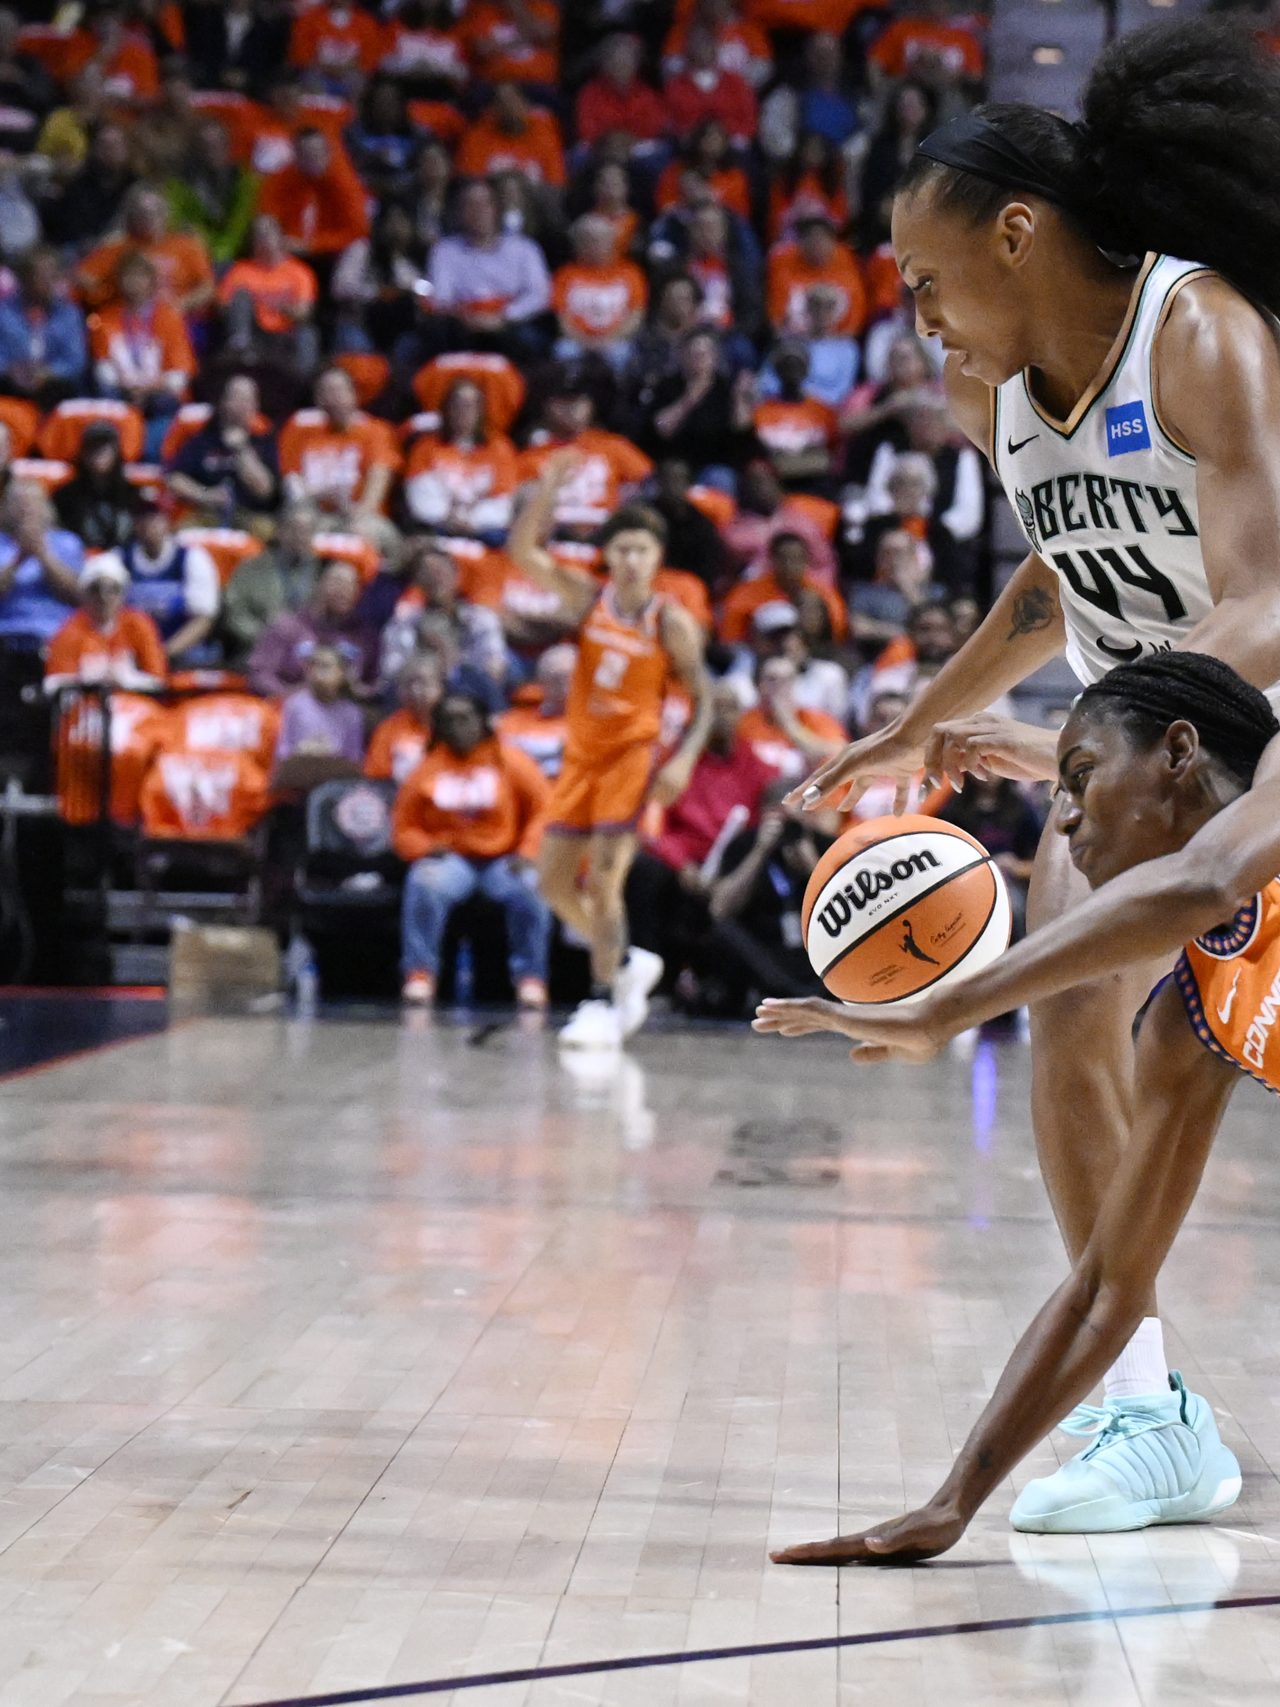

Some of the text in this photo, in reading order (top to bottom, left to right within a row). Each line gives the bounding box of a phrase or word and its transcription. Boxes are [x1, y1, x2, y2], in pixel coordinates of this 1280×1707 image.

[1110, 417, 1144, 440] HSS
[1051, 543, 1189, 623] 44
[816, 849, 942, 938] Wilson
[868, 892, 898, 916] EVO NXT
